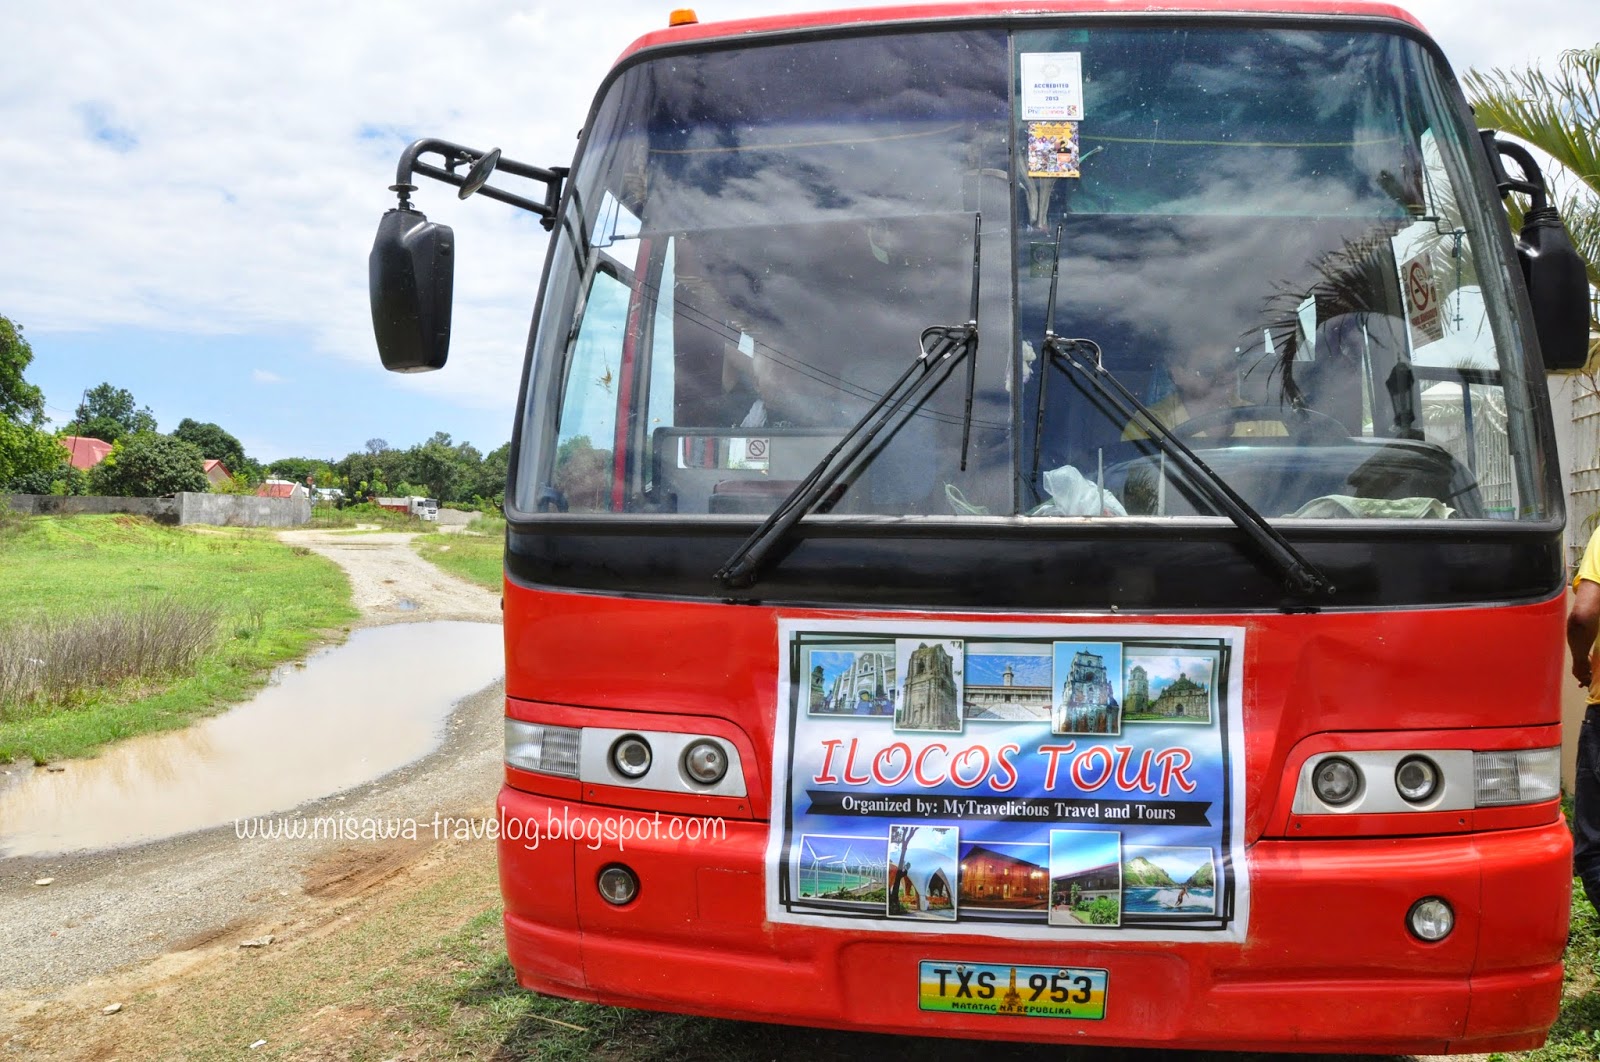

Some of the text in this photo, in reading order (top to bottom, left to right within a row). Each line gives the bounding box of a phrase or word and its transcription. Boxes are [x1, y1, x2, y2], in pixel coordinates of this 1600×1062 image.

[813, 738, 1197, 797] ILOCOS TOUR
[841, 795, 1176, 820] Organized by: MyTravelicious Travel and Tours
[934, 969, 1092, 1004] TXS 953
[952, 1002, 1072, 1015] MATATAG NA REPUBLIKA
